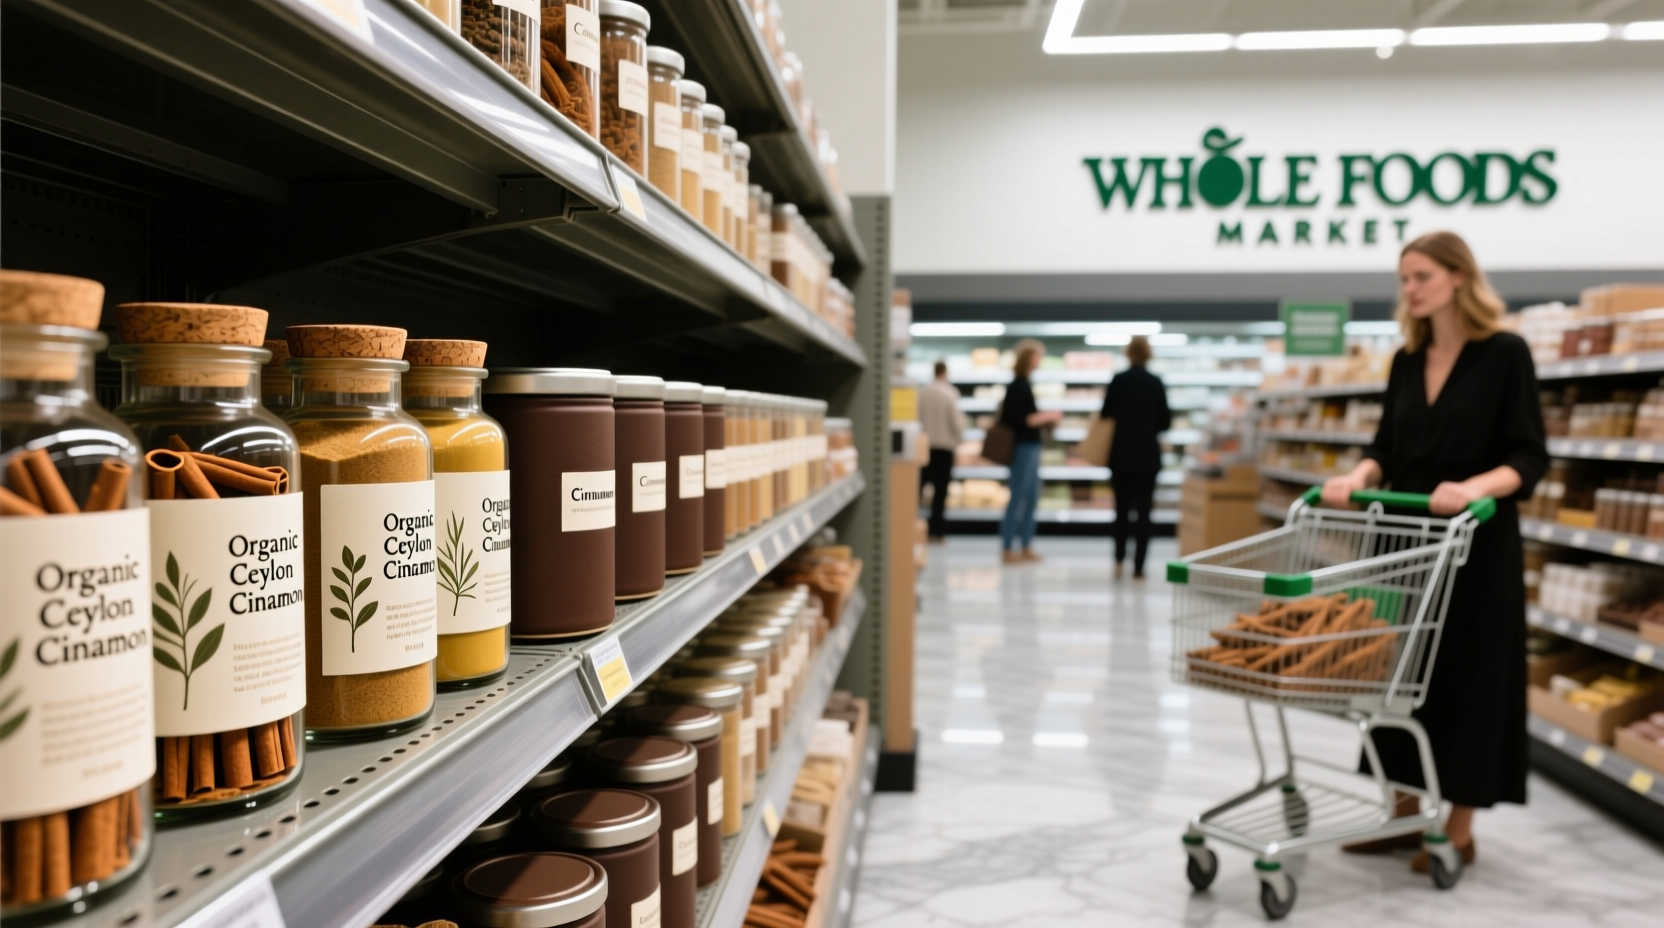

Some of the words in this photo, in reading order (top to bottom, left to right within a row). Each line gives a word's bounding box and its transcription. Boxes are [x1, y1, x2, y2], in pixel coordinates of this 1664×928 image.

[1083, 128, 1320, 210] WHOLE
[1338, 150, 1558, 208] FOODS
[1217, 219, 1411, 246] MARKET
[383, 508, 434, 537] Organic
[228, 528, 299, 562] Organic
[383, 532, 432, 560] Ceylon
[35, 554, 140, 598] Organic
[229, 558, 294, 591] Ceylon
[38, 594, 135, 635] Ceylon
[34, 628, 148, 667] Cinamon
